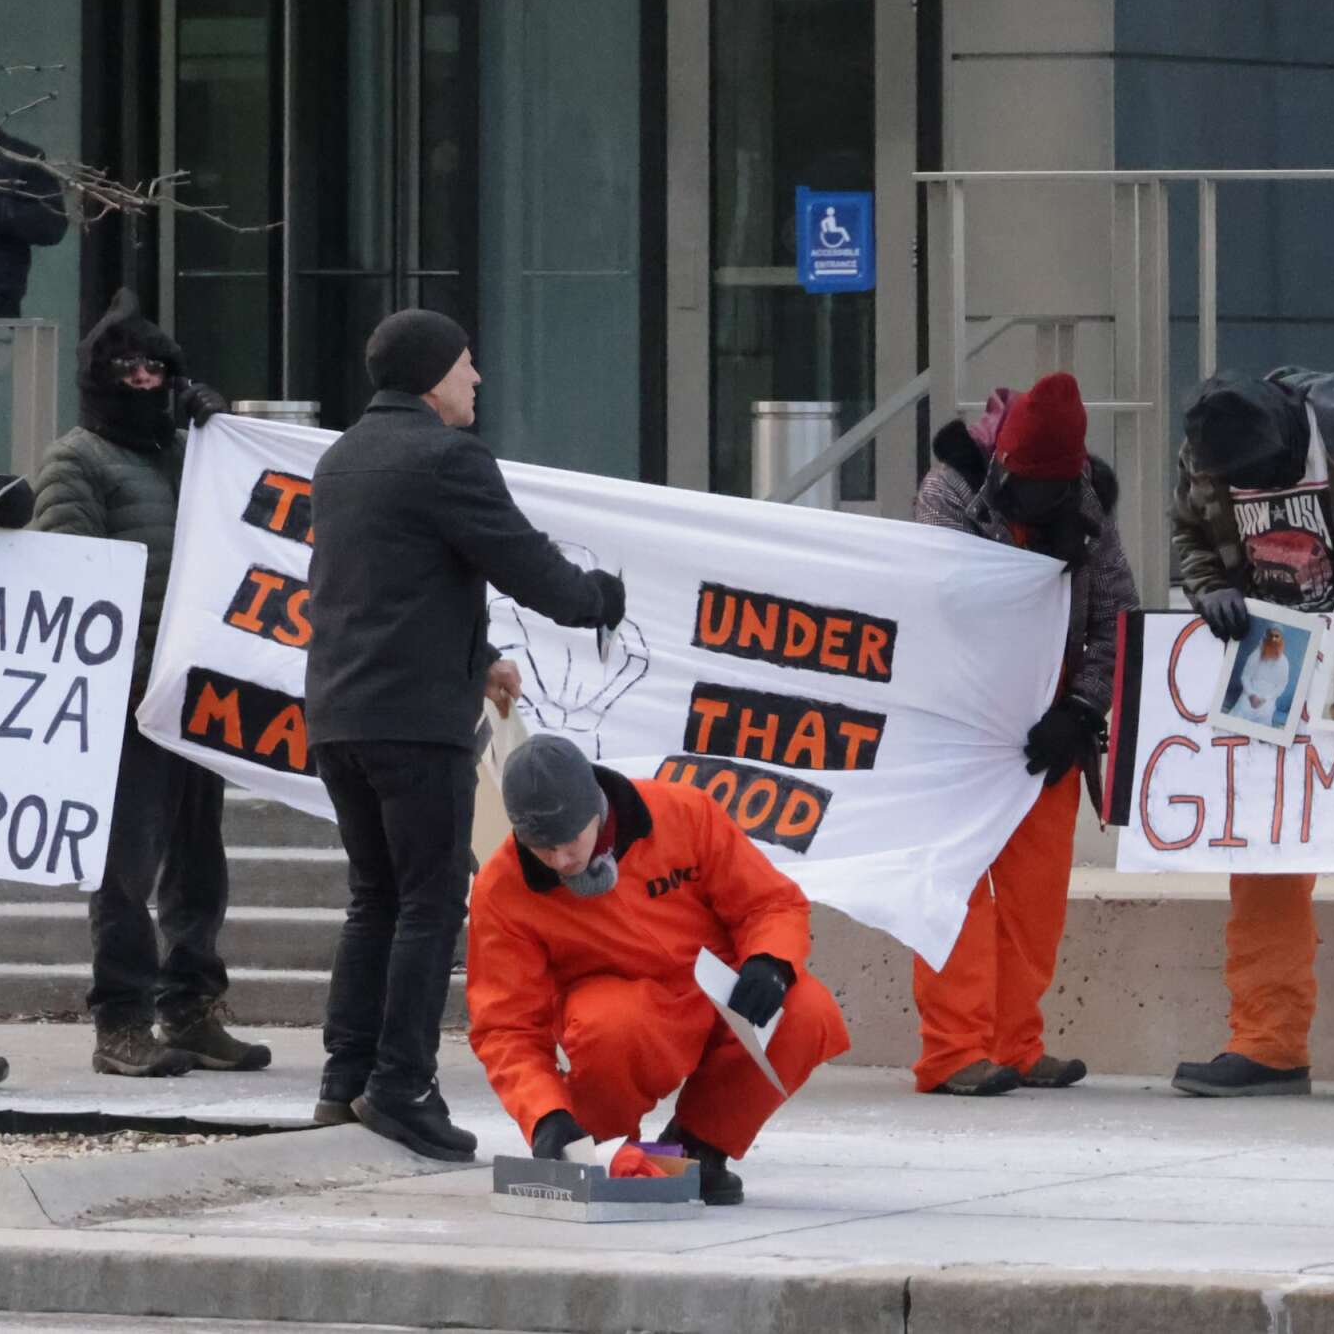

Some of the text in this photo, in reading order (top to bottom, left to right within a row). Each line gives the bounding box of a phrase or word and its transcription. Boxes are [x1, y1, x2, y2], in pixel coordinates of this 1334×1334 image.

[263, 472, 315, 544] T
[1285, 494, 1332, 549] USA
[698, 590, 889, 676] UNDER
[692, 697, 880, 771] THAT
